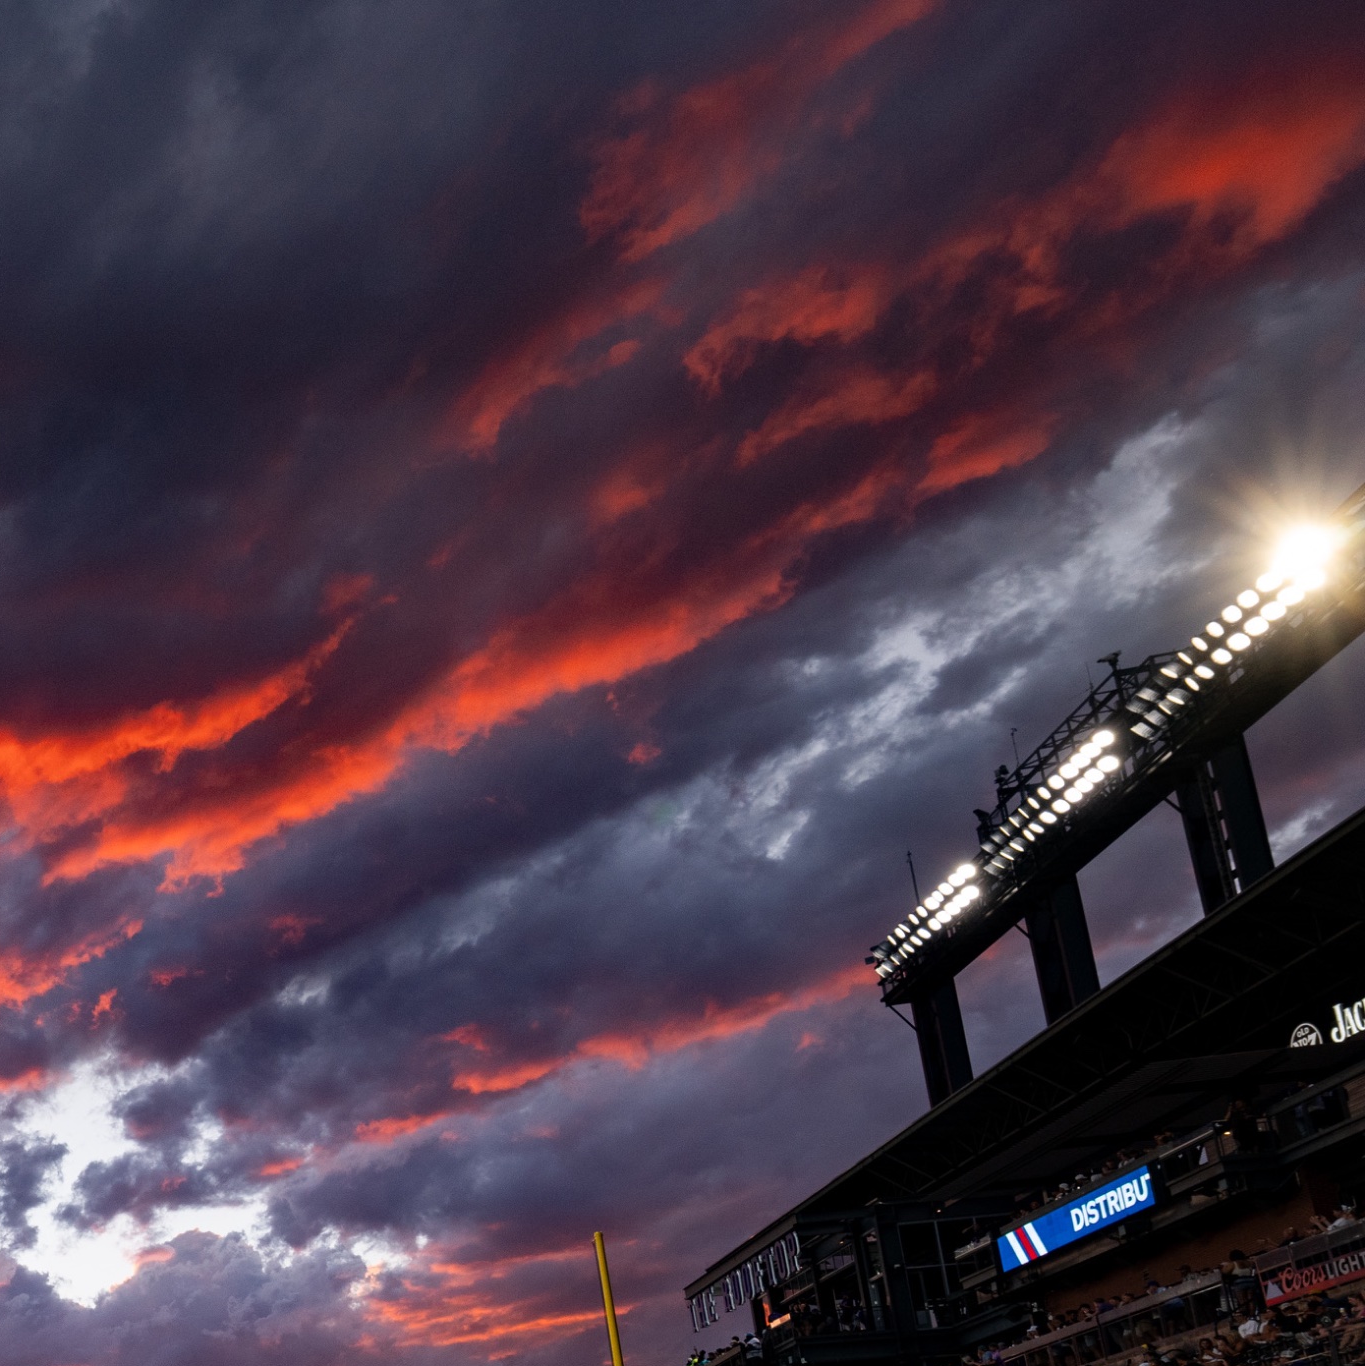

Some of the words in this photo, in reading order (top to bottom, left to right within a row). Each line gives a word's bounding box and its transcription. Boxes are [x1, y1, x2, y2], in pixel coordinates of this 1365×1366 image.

[1331, 998, 1365, 1043] JAC
[1070, 1173, 1150, 1232] DISTRIBU
[1279, 1265, 1325, 1293] Coors
[689, 1286, 720, 1333] THE
